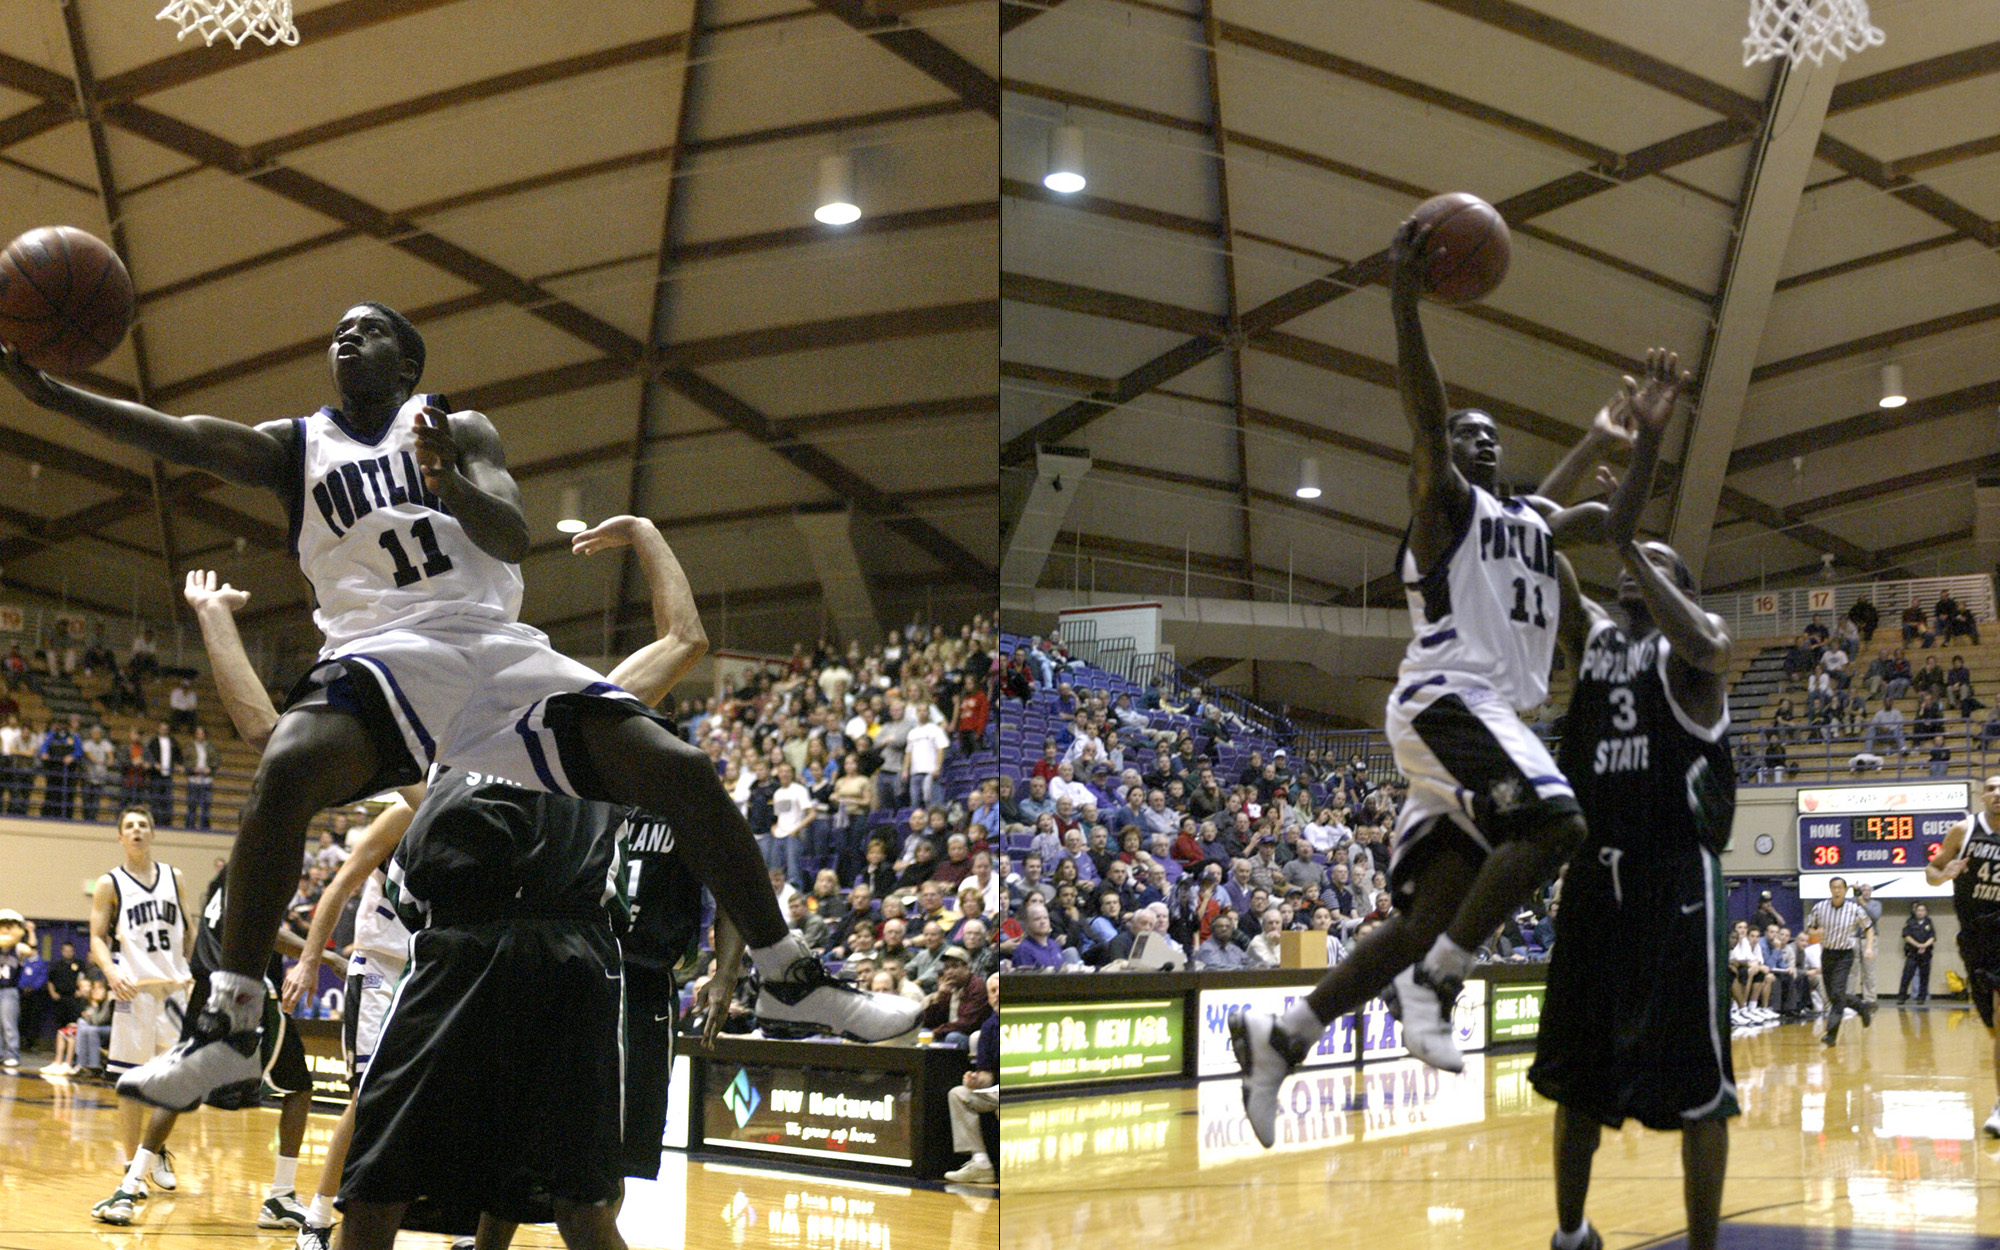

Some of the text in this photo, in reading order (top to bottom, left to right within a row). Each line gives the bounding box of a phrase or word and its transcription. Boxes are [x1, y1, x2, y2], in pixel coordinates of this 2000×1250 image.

[379, 517, 453, 588] 11
[1511, 577, 1546, 629] 11
[1755, 596, 1774, 612] 16
[1812, 592, 1829, 607] 17
[1608, 687, 1637, 730] 3
[1594, 735, 1649, 775] STATE
[1810, 824, 1842, 839] HOME
[1814, 845, 1840, 866] 36
[1856, 850, 1889, 861] PERIOD
[1892, 847, 1907, 864] 2
[1977, 861, 2000, 883] 42
[204, 887, 222, 929] 4
[145, 929, 170, 953] 15
[1000, 1022, 1043, 1055] SAME
[1095, 1018, 1131, 1048] NEW
[771, 1089, 894, 1122] NW Natural
